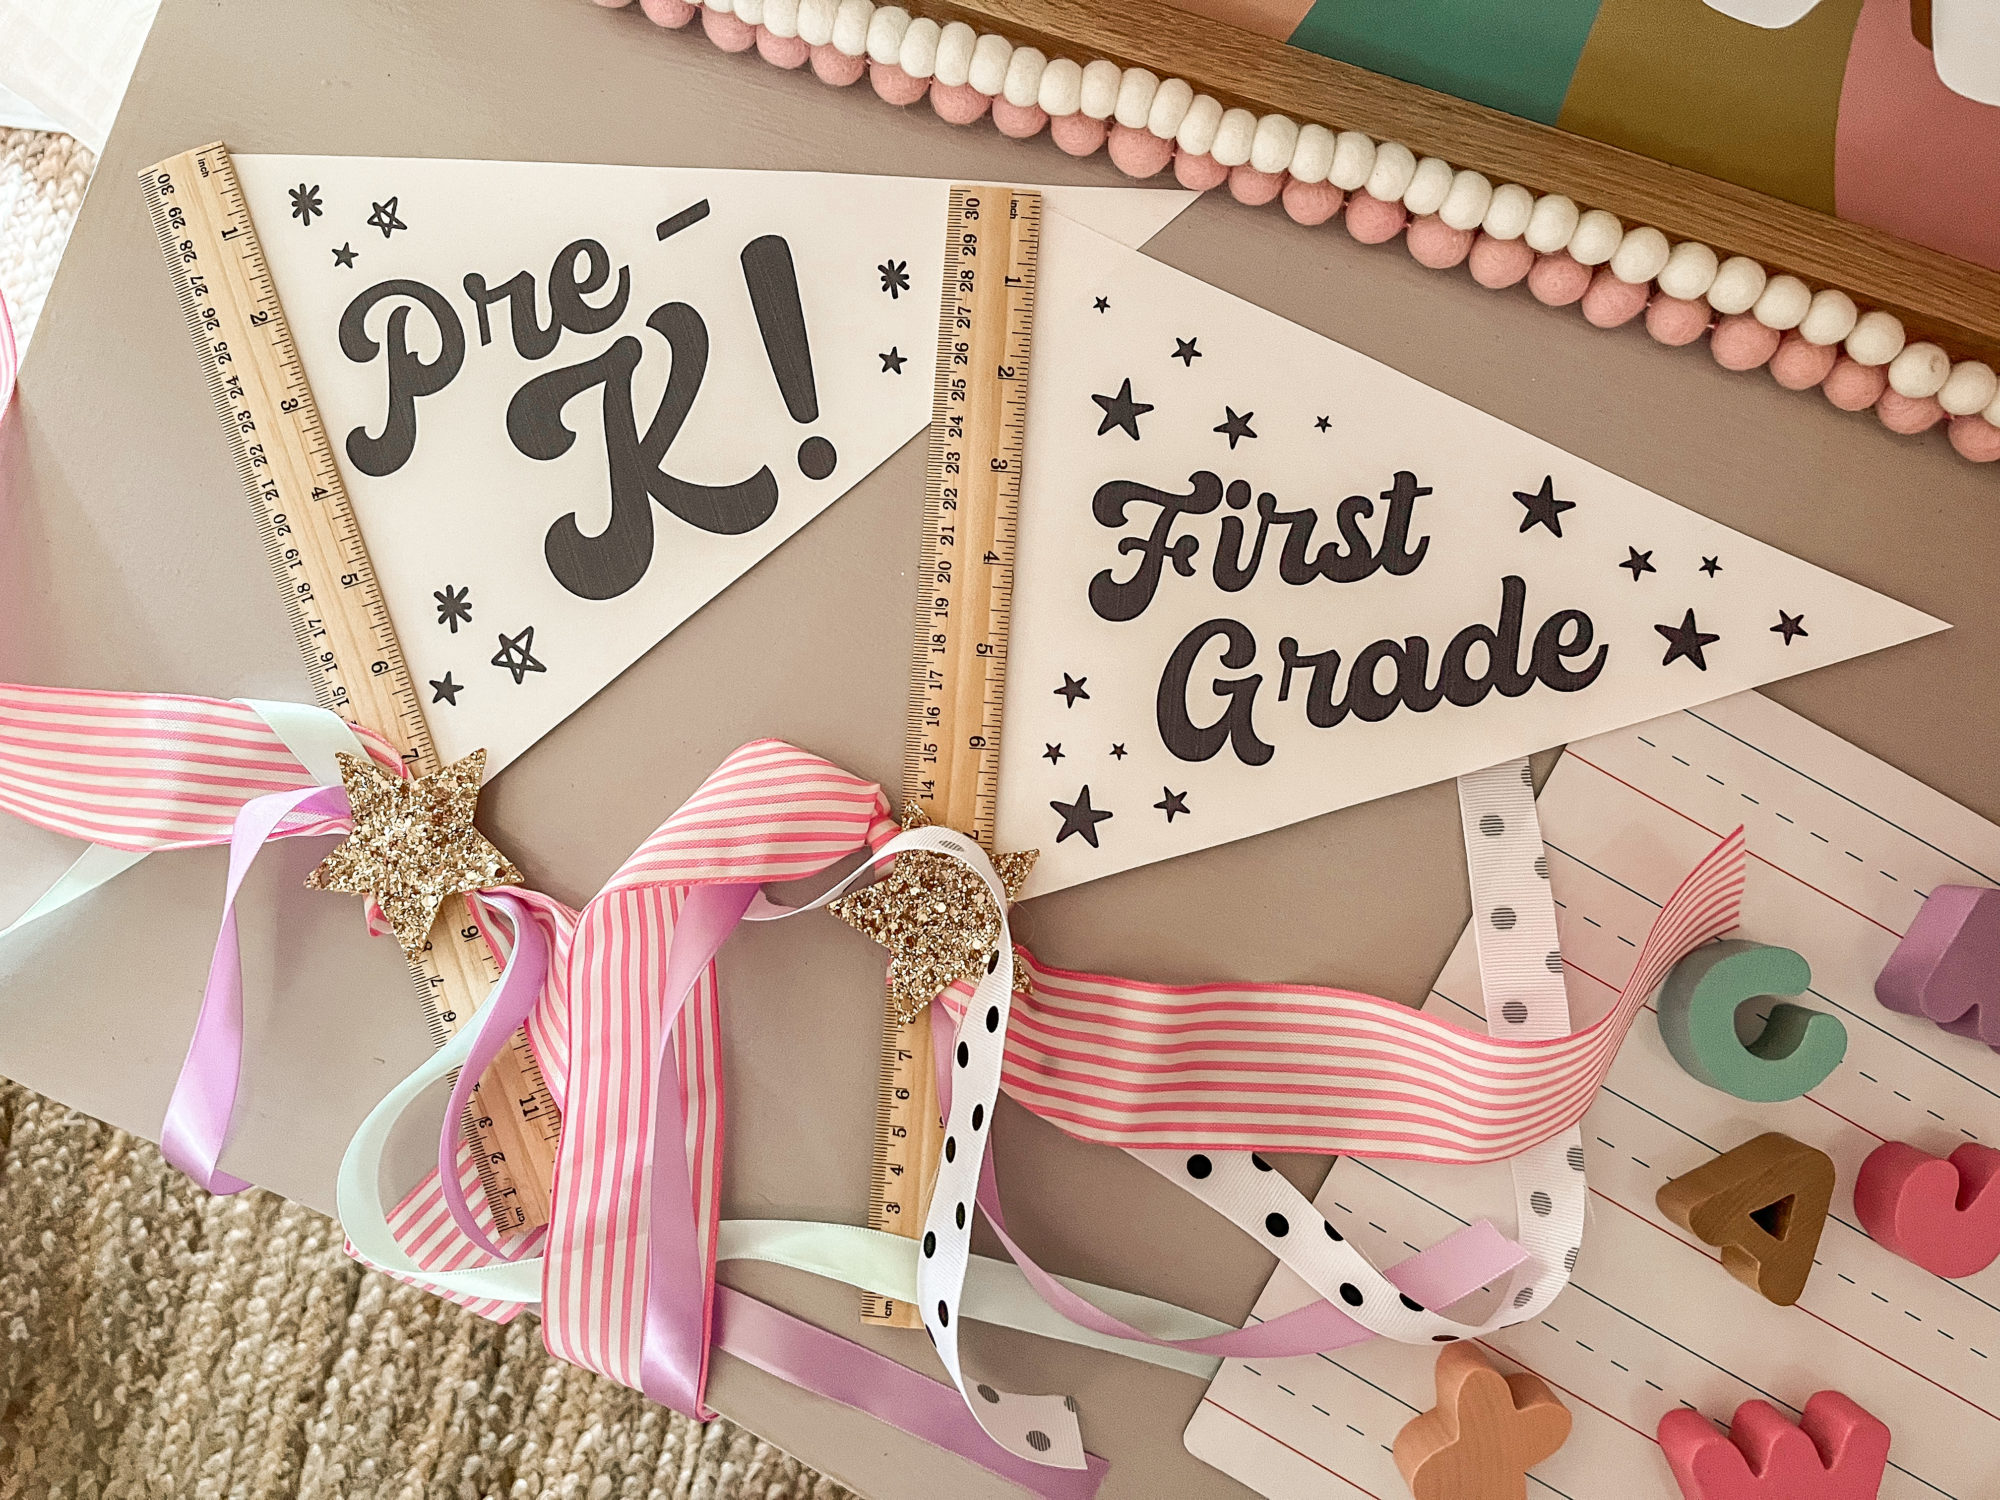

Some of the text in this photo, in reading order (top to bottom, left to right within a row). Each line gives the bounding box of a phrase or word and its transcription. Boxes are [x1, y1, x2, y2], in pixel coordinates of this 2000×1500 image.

[197, 158, 210, 178] inch
[157, 173, 176, 195] 30
[168, 207, 187, 230] 29
[964, 197, 980, 220] 30
[1009, 199, 1020, 220] inch
[221, 226, 239, 238] 1
[179, 239, 198, 263] 28
[962, 233, 978, 257] 29
[190, 275, 208, 297] 27
[959, 269, 975, 292] 28
[1004, 275, 1021, 285] 1
[202, 307, 220, 331] 26
[249, 311, 268, 325] 2
[956, 306, 972, 329] 27
[213, 341, 232, 365] 25
[954, 342, 970, 366] 26
[997, 365, 1015, 378] 2
[225, 375, 244, 399] 24
[950, 378, 967, 402] 25
[280, 397, 299, 412] 3
[237, 410, 256, 434] 23
[506, 234, 837, 600] K!
[948, 415, 964, 438] 24
[249, 444, 268, 468] 22
[945, 451, 961, 474] 23
[990, 458, 1008, 470] 3
[261, 479, 280, 501] 21
[311, 486, 328, 500] 4
[942, 487, 958, 510] 22
[273, 514, 292, 537] 20
[939, 525, 955, 546] 21
[983, 550, 1000, 563] 4
[1088, 470, 1433, 622] First
[285, 548, 303, 569] 19
[341, 573, 359, 586] 5
[936, 560, 952, 583] 20
[297, 582, 314, 604] 18
[934, 597, 950, 618] 19
[308, 618, 327, 638] 17
[932, 633, 947, 654] 18
[976, 643, 993, 655] 5
[320, 651, 338, 673] 16
[371, 660, 389, 674] 6
[1156, 575, 1609, 766] Grade
[929, 670, 944, 690] 17
[332, 686, 350, 707] 15
[926, 706, 941, 726] 16
[969, 735, 987, 747] 6
[401, 747, 419, 760] 7
[923, 743, 938, 764] 15
[920, 779, 935, 800] 14
[460, 925, 479, 938] 9
[430, 978, 444, 988] 7
[442, 1011, 457, 1023] 6
[898, 1051, 913, 1061] 7
[895, 1089, 910, 1100] 6
[519, 1094, 540, 1118] 11
[479, 1117, 493, 1129] 3
[892, 1127, 907, 1138] 5
[491, 1151, 506, 1165] 2
[890, 1165, 904, 1176] 4
[503, 1188, 517, 1200] 1
[515, 1206, 526, 1222] cm
[886, 1203, 901, 1214] 3
[885, 1300, 893, 1317] cm
